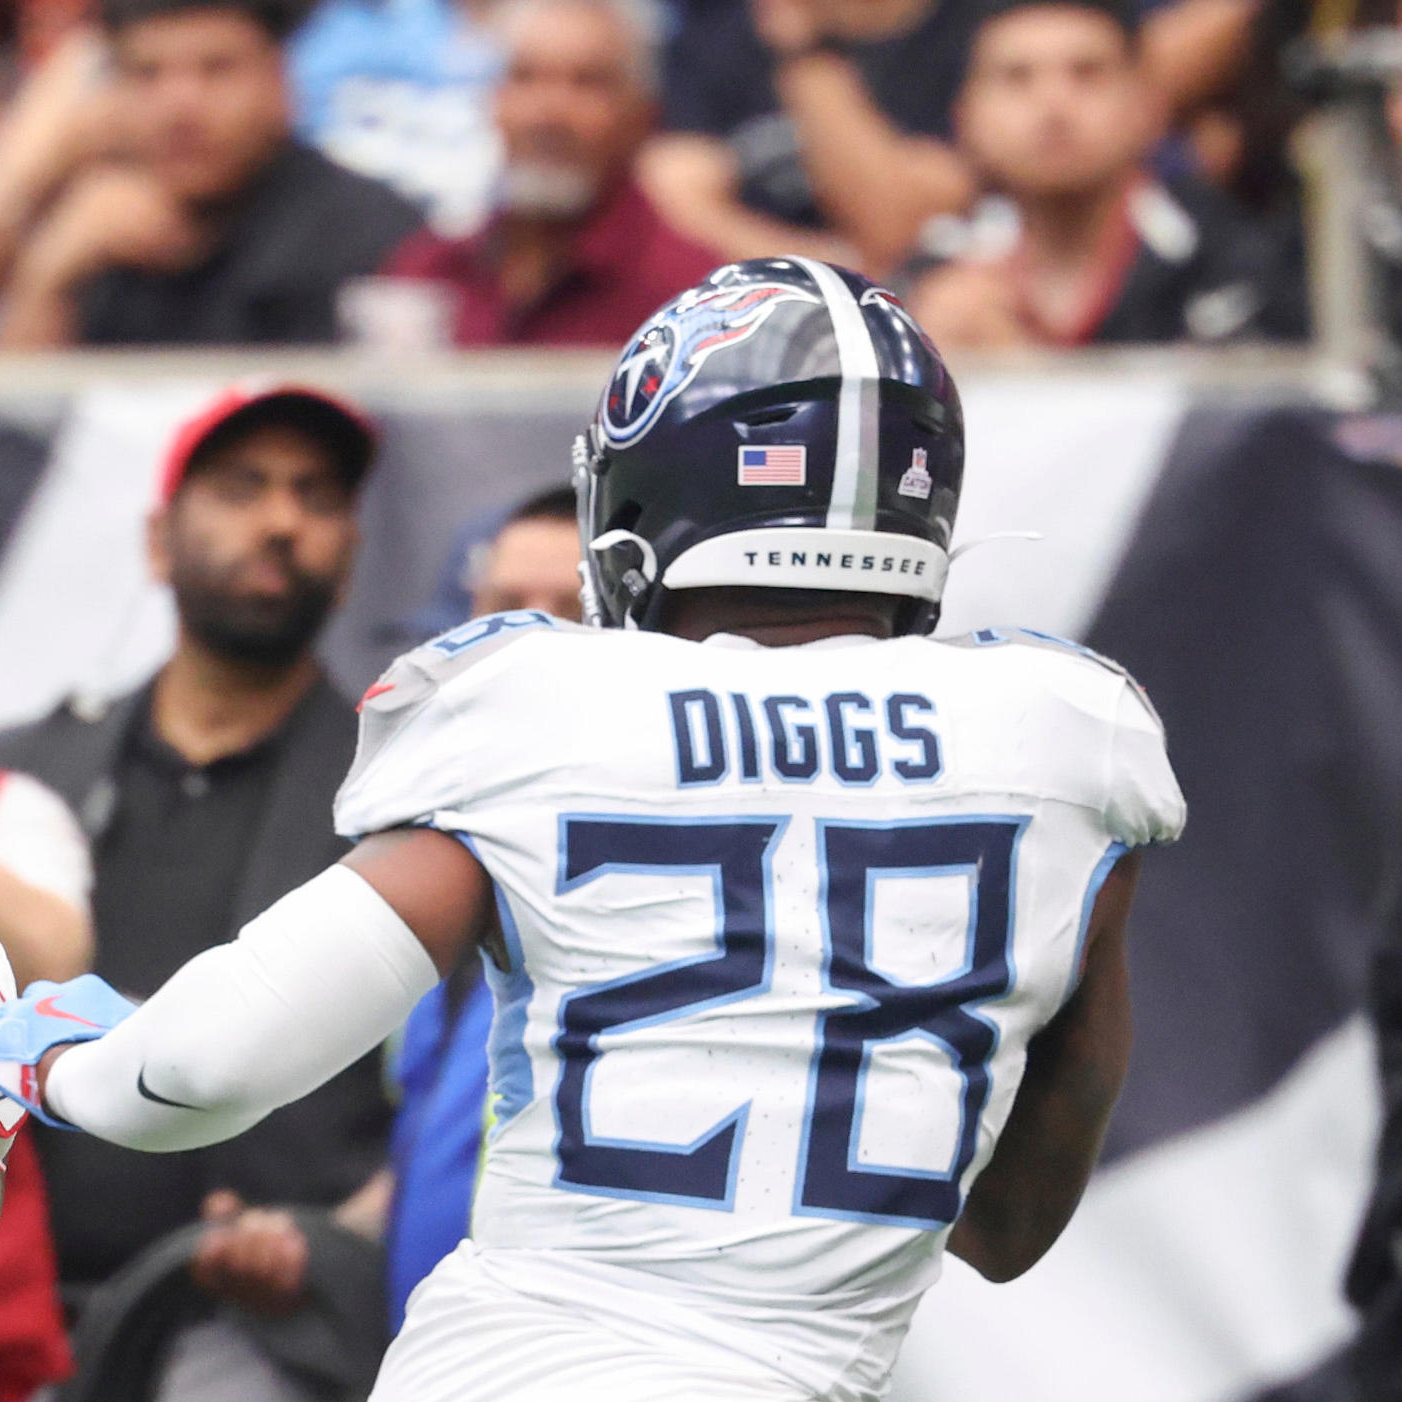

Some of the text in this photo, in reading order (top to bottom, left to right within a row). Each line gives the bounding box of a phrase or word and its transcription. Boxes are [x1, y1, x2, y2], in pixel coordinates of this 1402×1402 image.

[745, 552, 926, 576] TENNESSEE
[666, 687, 945, 789] DIGGS
[552, 813, 1033, 1230] 28
